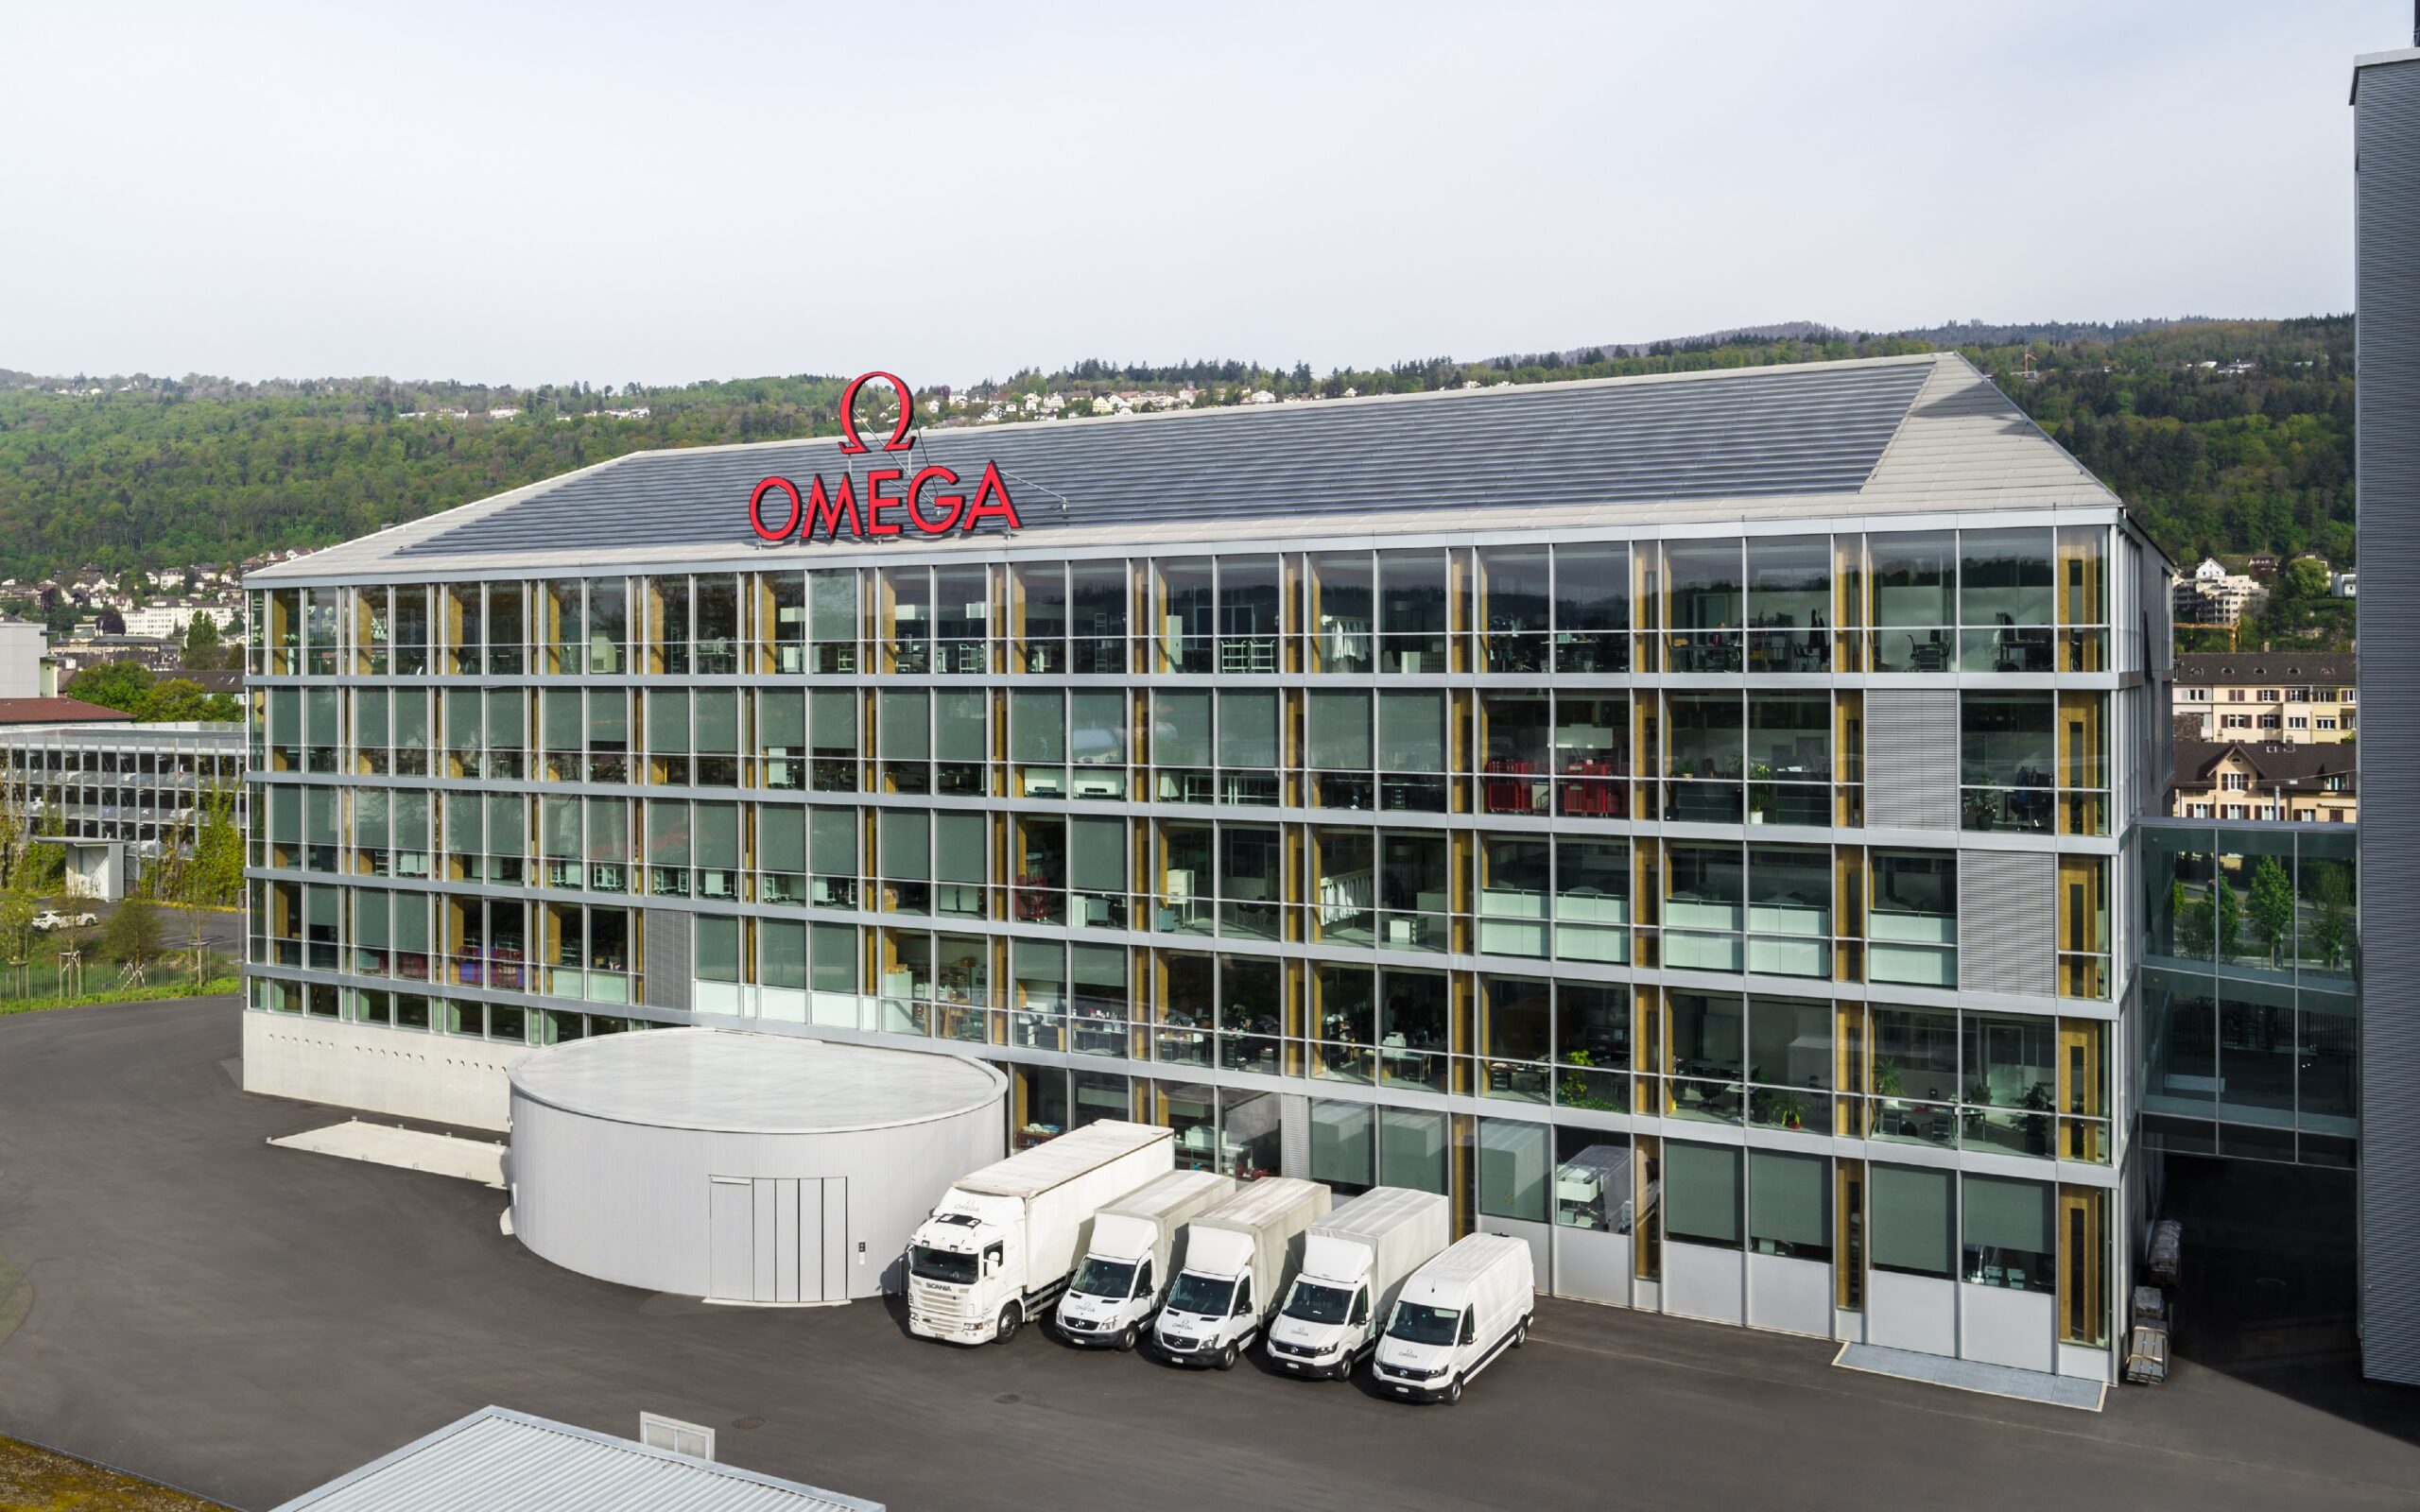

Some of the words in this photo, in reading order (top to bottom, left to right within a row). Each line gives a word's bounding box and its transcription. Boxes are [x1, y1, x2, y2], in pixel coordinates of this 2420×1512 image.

[750, 460, 1022, 541] OMEGA
[954, 1204, 979, 1212] OMEGA
[926, 1281, 952, 1292] SCANIA
